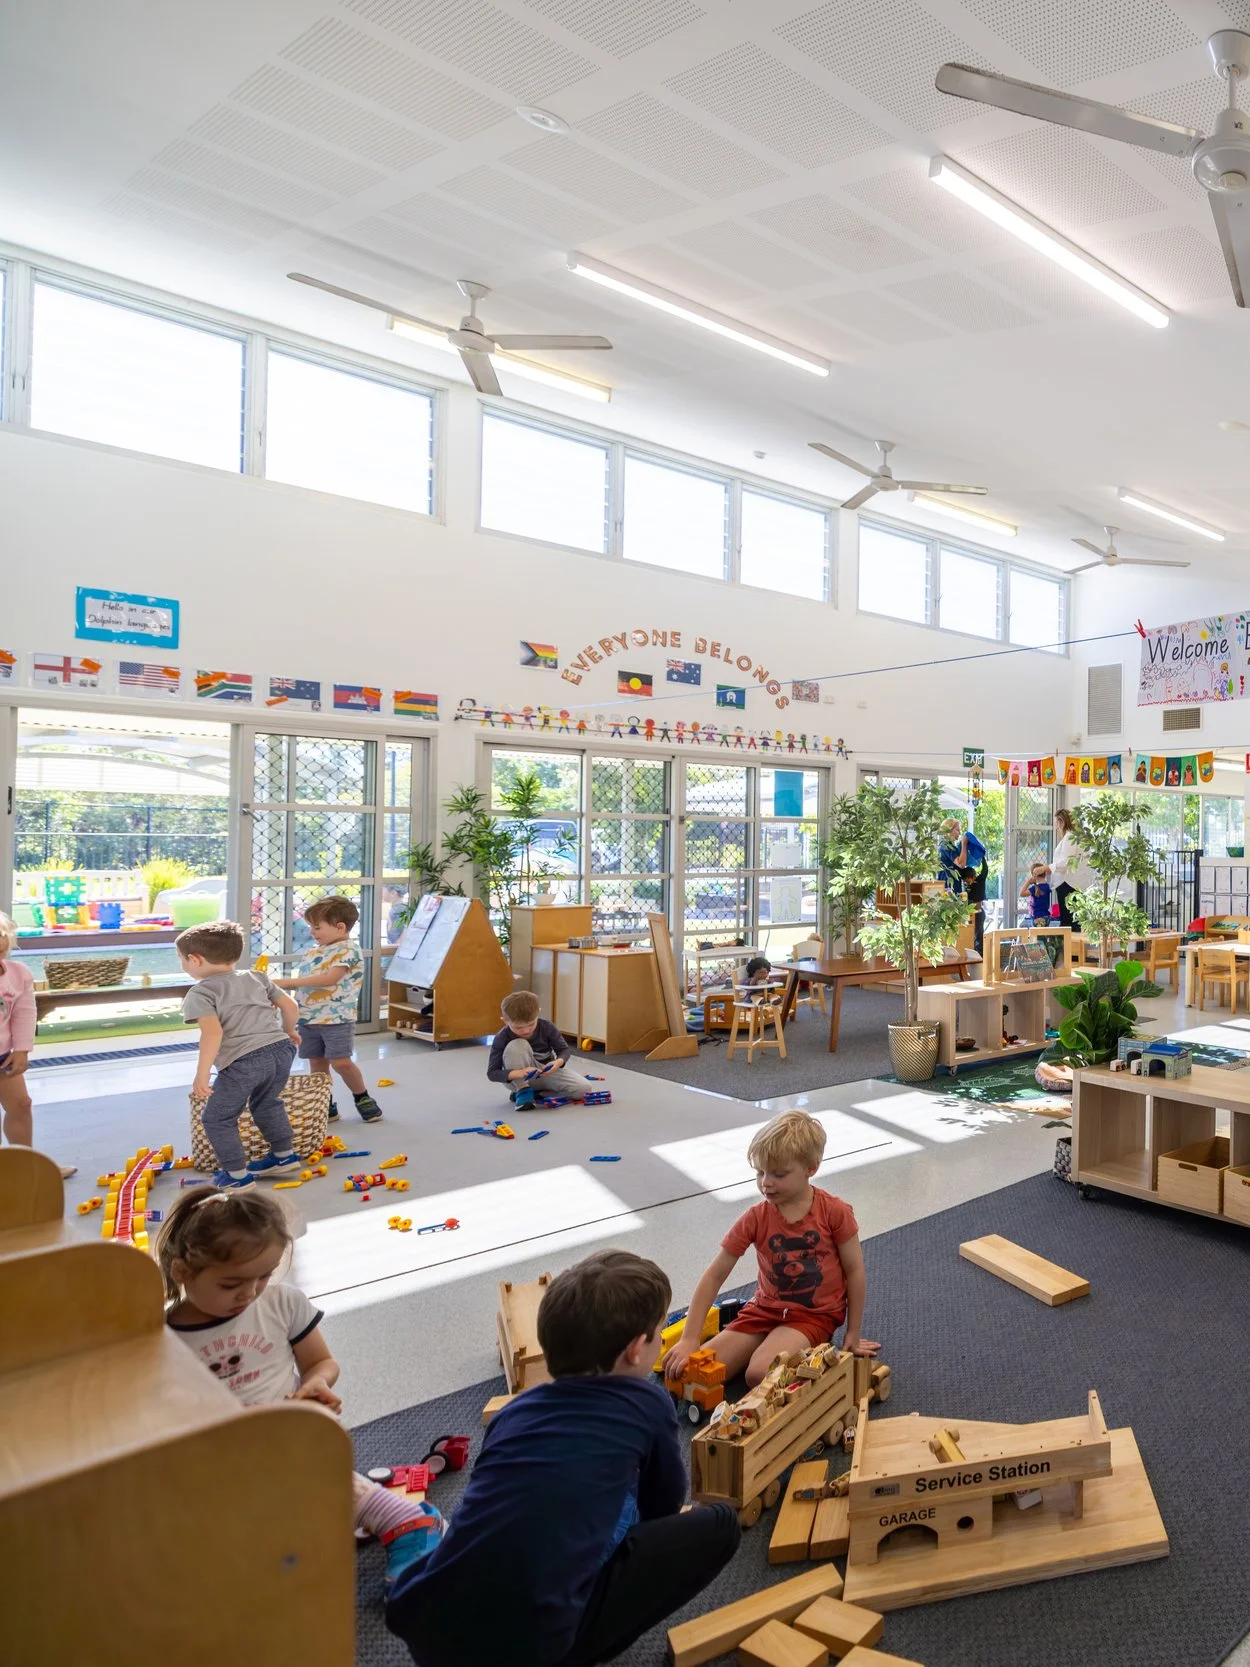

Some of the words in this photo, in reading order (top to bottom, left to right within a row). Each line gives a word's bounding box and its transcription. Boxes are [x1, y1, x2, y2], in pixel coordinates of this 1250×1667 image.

[101, 601, 124, 611] Hello
[88, 613, 122, 627] Dolphin
[1147, 632, 1230, 664] Welcome
[561, 629, 681, 686] EVERYONE
[694, 637, 790, 710] BELONGS
[915, 1472, 983, 1493] Service
[988, 1461, 1051, 1481] Station
[879, 1508, 936, 1527] GARAGE
